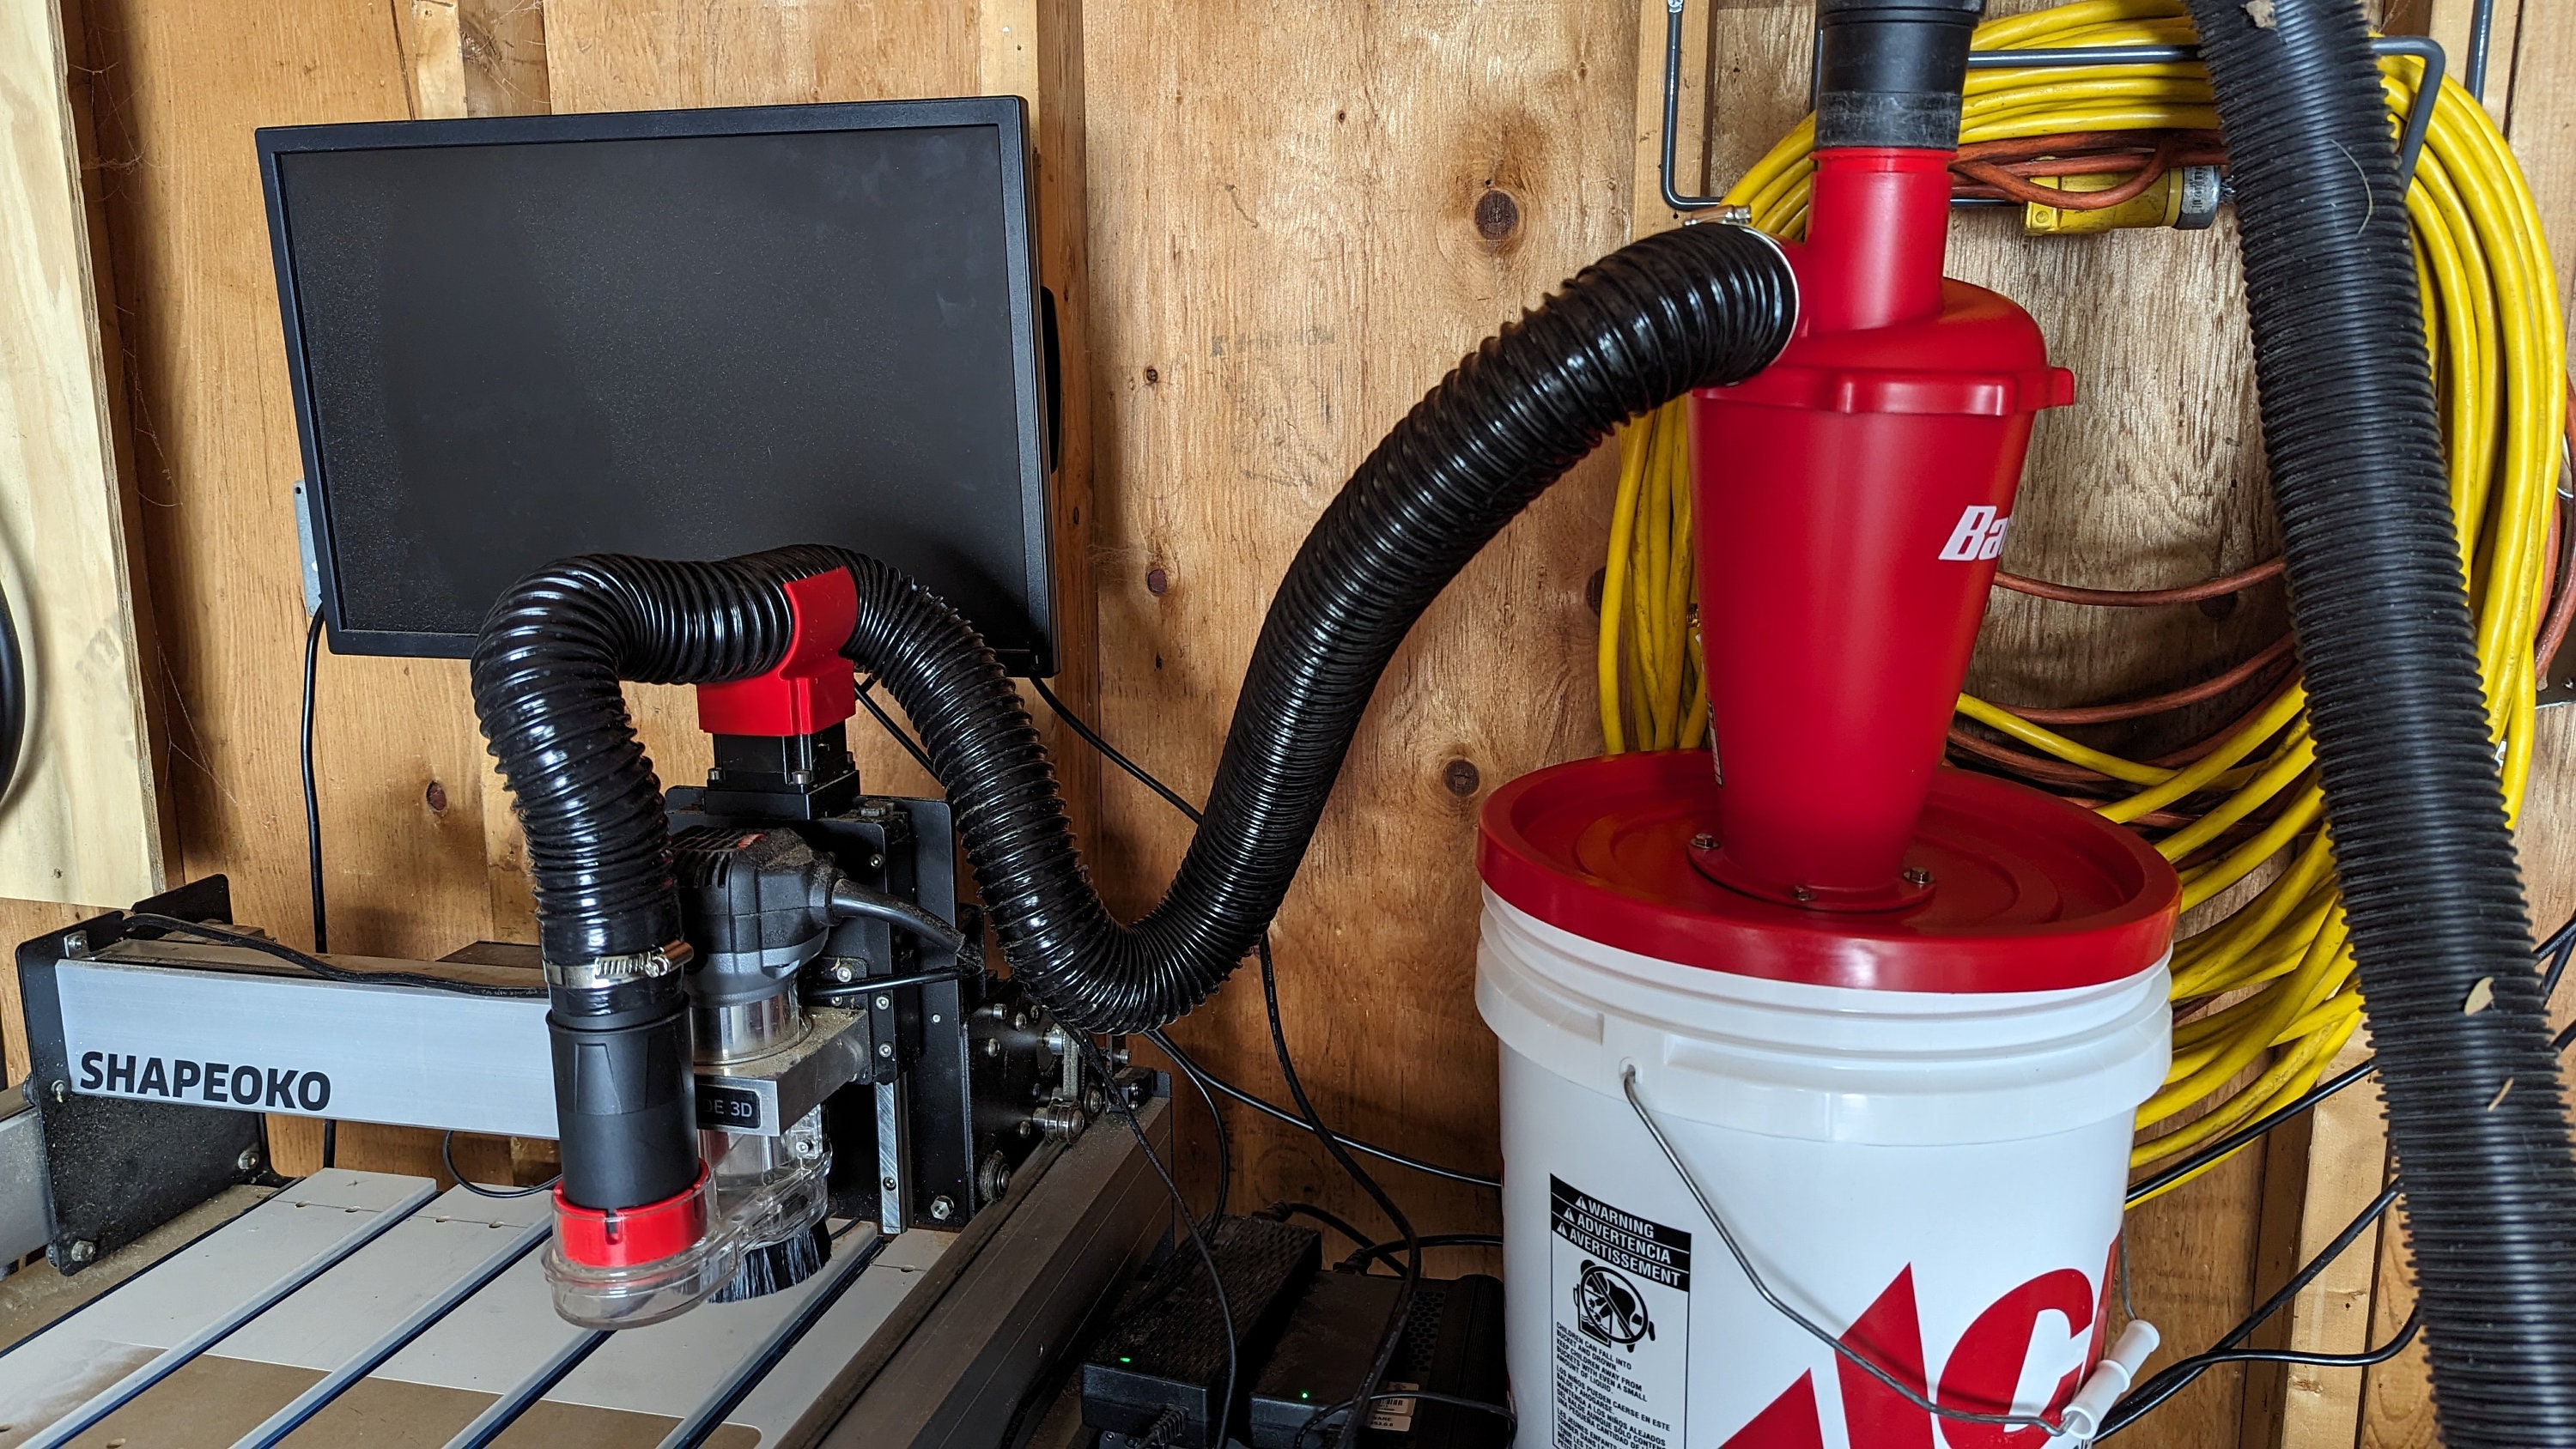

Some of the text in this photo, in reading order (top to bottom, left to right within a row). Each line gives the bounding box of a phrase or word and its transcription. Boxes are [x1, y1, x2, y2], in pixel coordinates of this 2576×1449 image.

[1938, 505, 2008, 561] Ba
[80, 1050, 332, 1112] SHAPEOKO
[730, 1100, 753, 1118] 3D
[1577, 1214, 1671, 1264] ADVERTENCIA
[1589, 1200, 1654, 1239] WARNING
[1570, 1228, 1680, 1286] AVERTISSEMENT
[1557, 1322, 1631, 1370] CHILDREN CAN FALL INTO
[1557, 1329, 1619, 1372] BUCKET AND DROWN.
[1717, 1226, 2122, 1449] AC
[1557, 1338, 1643, 1391] KEEP CHILDREN AWAY FROM
[1557, 1354, 1579, 1373] AMOUNT
[1581, 1370, 1589, 1379] OF
[1557, 1345, 1580, 1367] BUCKETS
[1582, 1363, 1597, 1377] WITH
[1599, 1373, 1615, 1387] EVEN
[1623, 1385, 1648, 1402] SMALL
[1557, 1373, 1573, 1389] BALDE
[1557, 1365, 1567, 1377] LOS
[1587, 1385, 1612, 1404] PUEDEN
[1613, 1400, 1640, 1419] CAERSE
[1641, 1414, 1650, 1423] EN
[1652, 1419, 1670, 1432] ESTE
[1557, 1388, 1567, 1401] DEL
[1568, 1397, 1585, 1414] BALDE
[1587, 1410, 1612, 1430] AUNQUE
[1557, 1380, 1586, 1407] MANTENGA
[1594, 1406, 1605, 1418] LOS
[1630, 1426, 1666, 1446] ALEJADOS
[1557, 1396, 1568, 1409] UNA
[1596, 1423, 1629, 1446] CANTIDAD
[1558, 1407, 1567, 1420] LES
[1568, 1416, 1589, 1435] JEUNES
[1558, 1415, 1596, 1447] TOMBER DANS
[1573, 1435, 1583, 1448] LES
